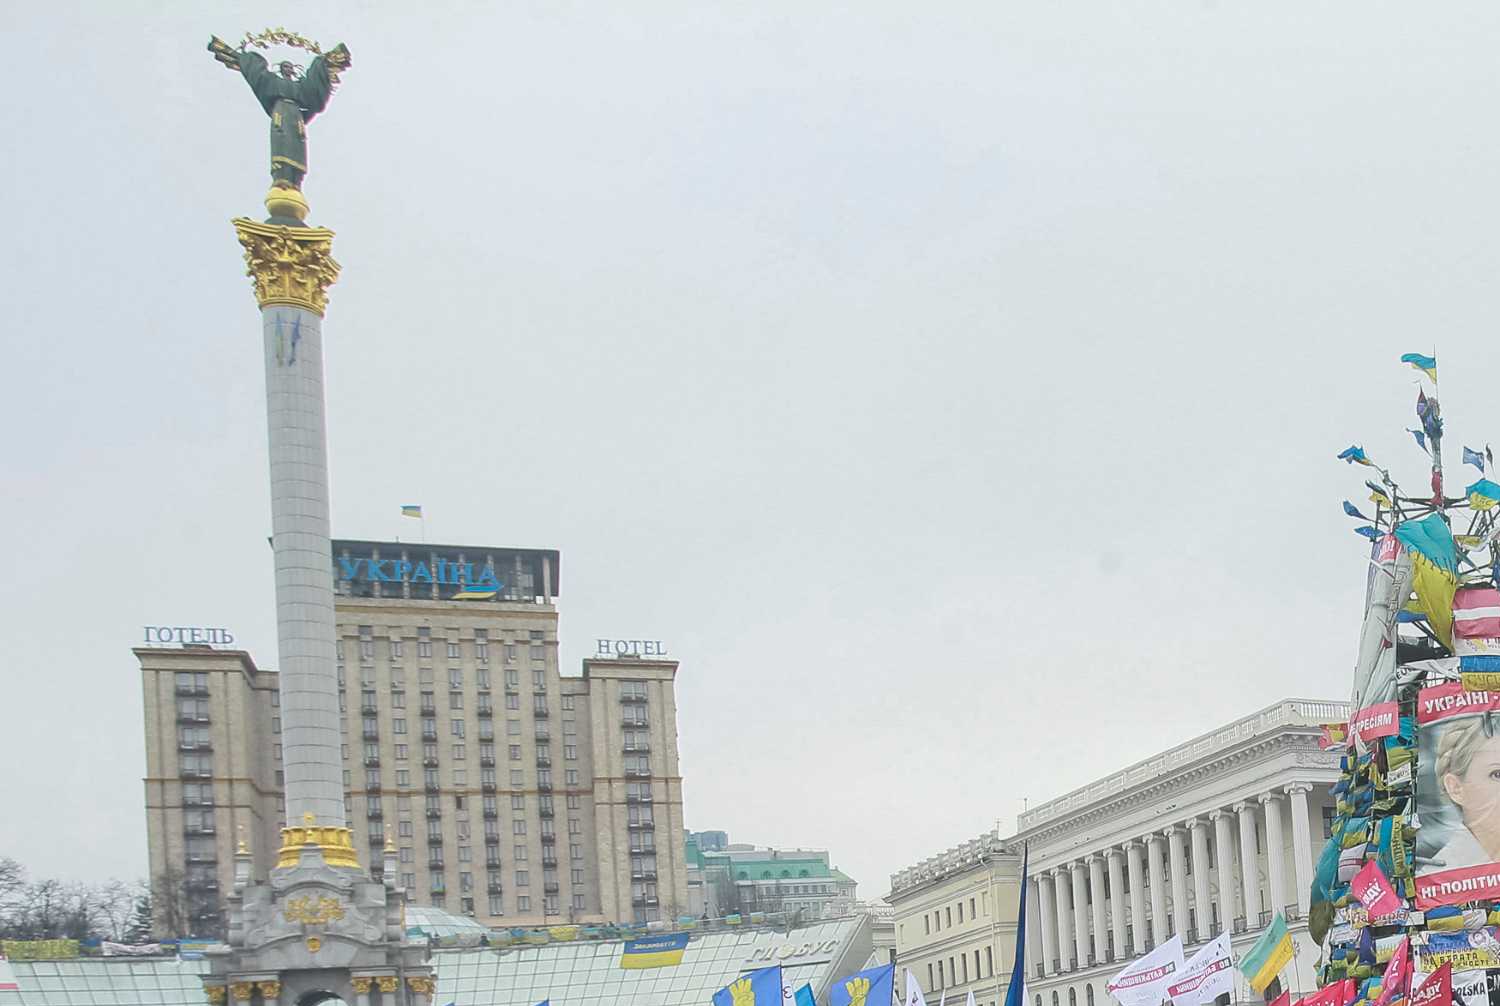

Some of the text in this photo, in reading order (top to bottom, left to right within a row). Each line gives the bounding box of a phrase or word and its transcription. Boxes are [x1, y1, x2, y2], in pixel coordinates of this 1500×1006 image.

[341, 557, 499, 585] УКРАЇНА
[144, 626, 234, 645] ГОТЕЛЬ
[597, 639, 667, 656] HOTEL
[1425, 691, 1489, 714] УКРАЇНІ
[1421, 886, 1436, 899] НІ
